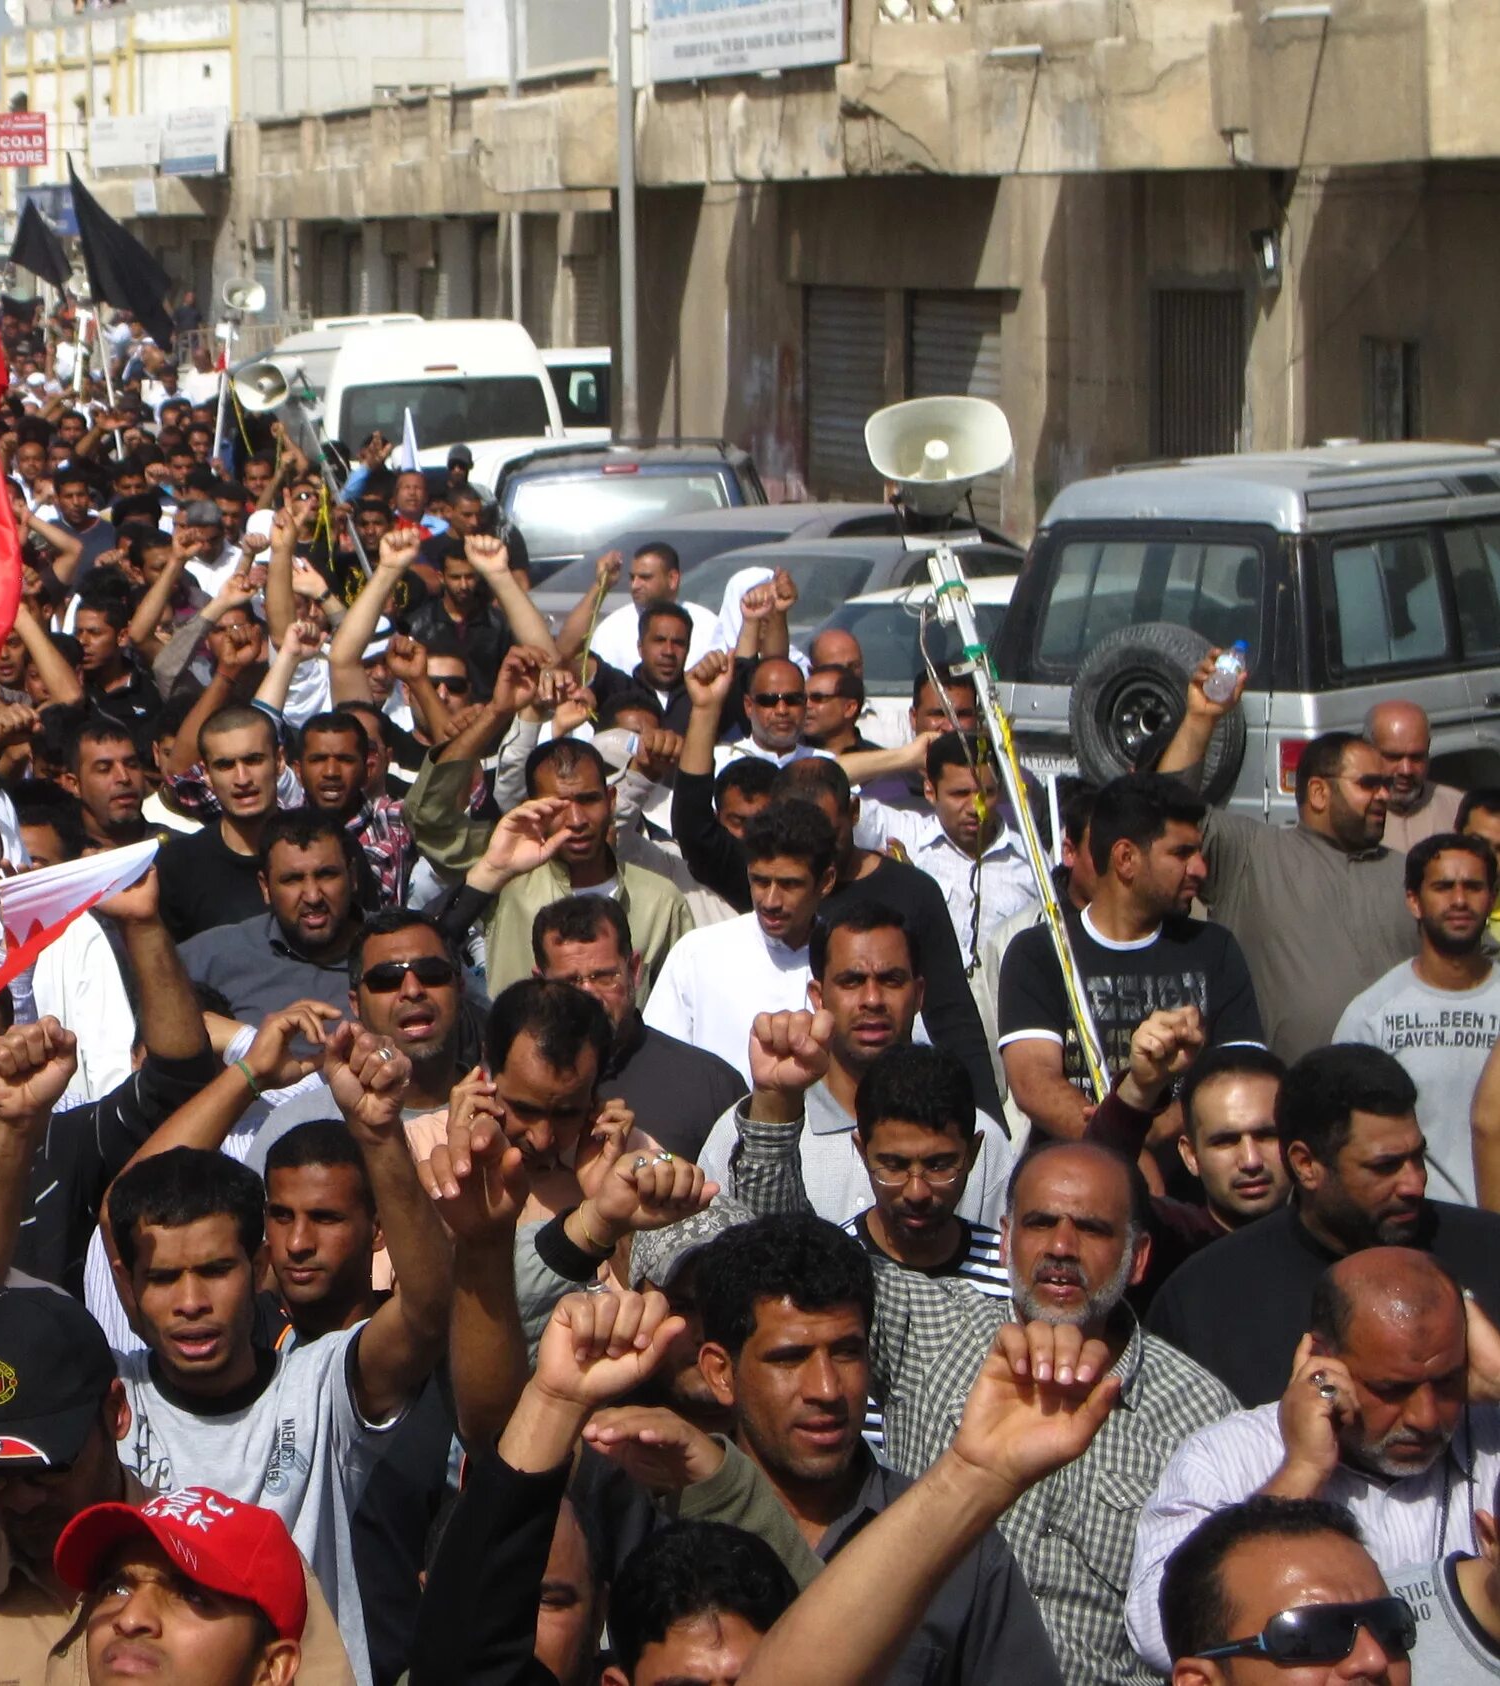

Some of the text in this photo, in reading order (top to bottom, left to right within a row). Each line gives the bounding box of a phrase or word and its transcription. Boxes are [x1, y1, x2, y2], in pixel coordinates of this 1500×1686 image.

[0, 135, 44, 149] COLD
[0, 150, 44, 164] STORE
[1086, 972, 1208, 1022] ESIGN
[1489, 1014, 1500, 1031] T
